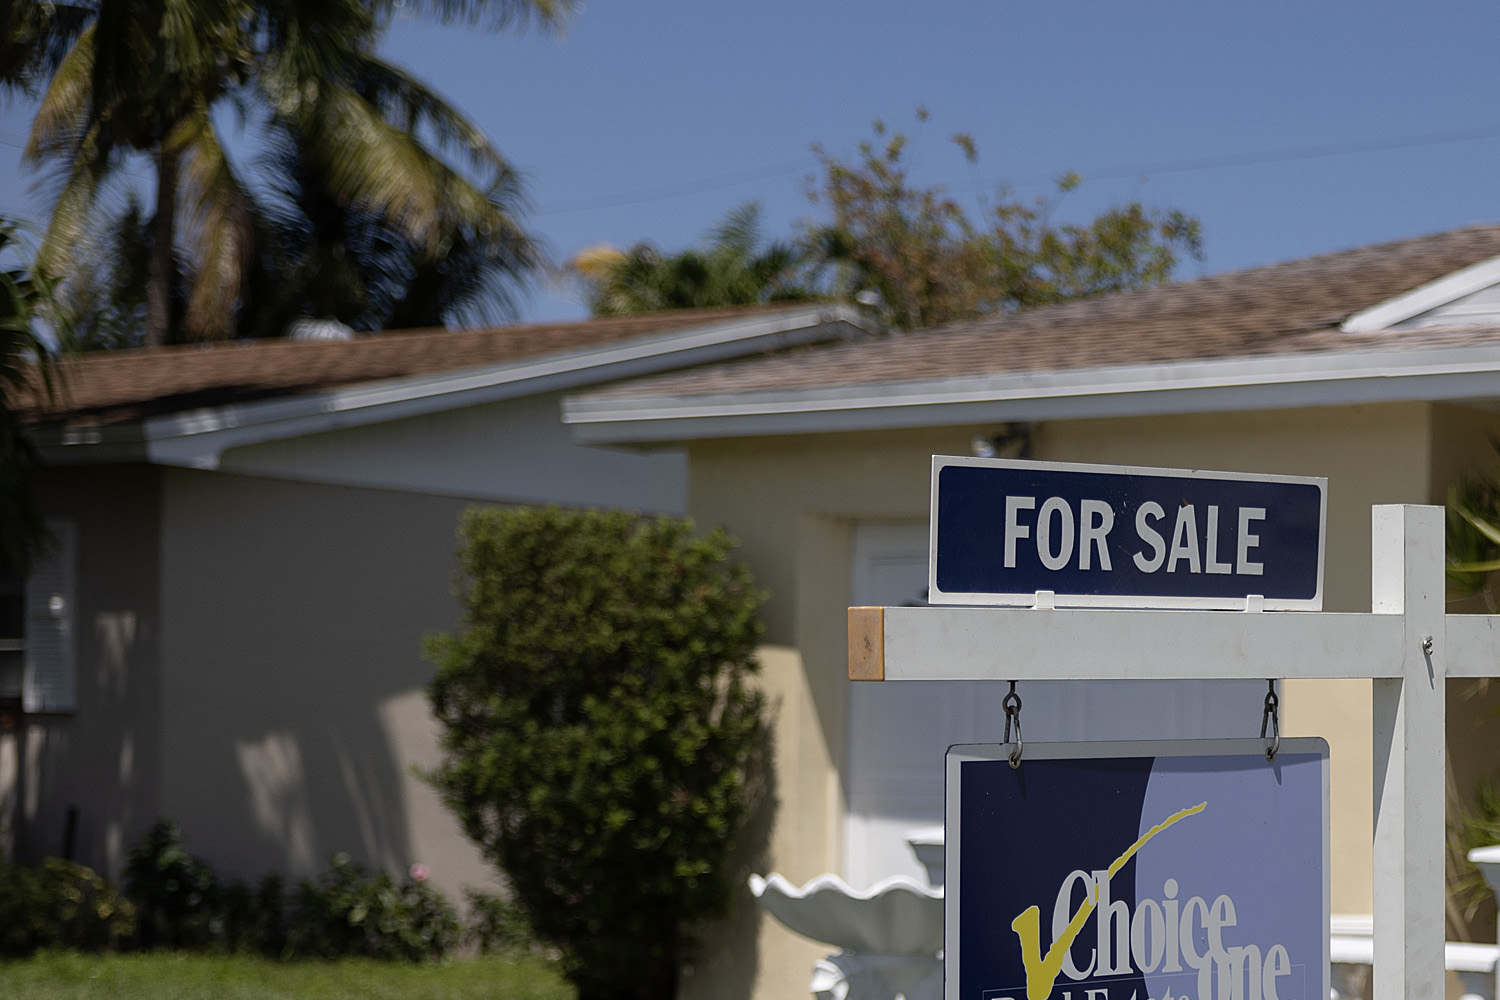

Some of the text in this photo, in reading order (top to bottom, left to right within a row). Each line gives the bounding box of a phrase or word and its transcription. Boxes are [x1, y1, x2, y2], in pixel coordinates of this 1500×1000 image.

[1003, 495, 1267, 576] FOR SALE
[1052, 869, 1238, 981] Choice
